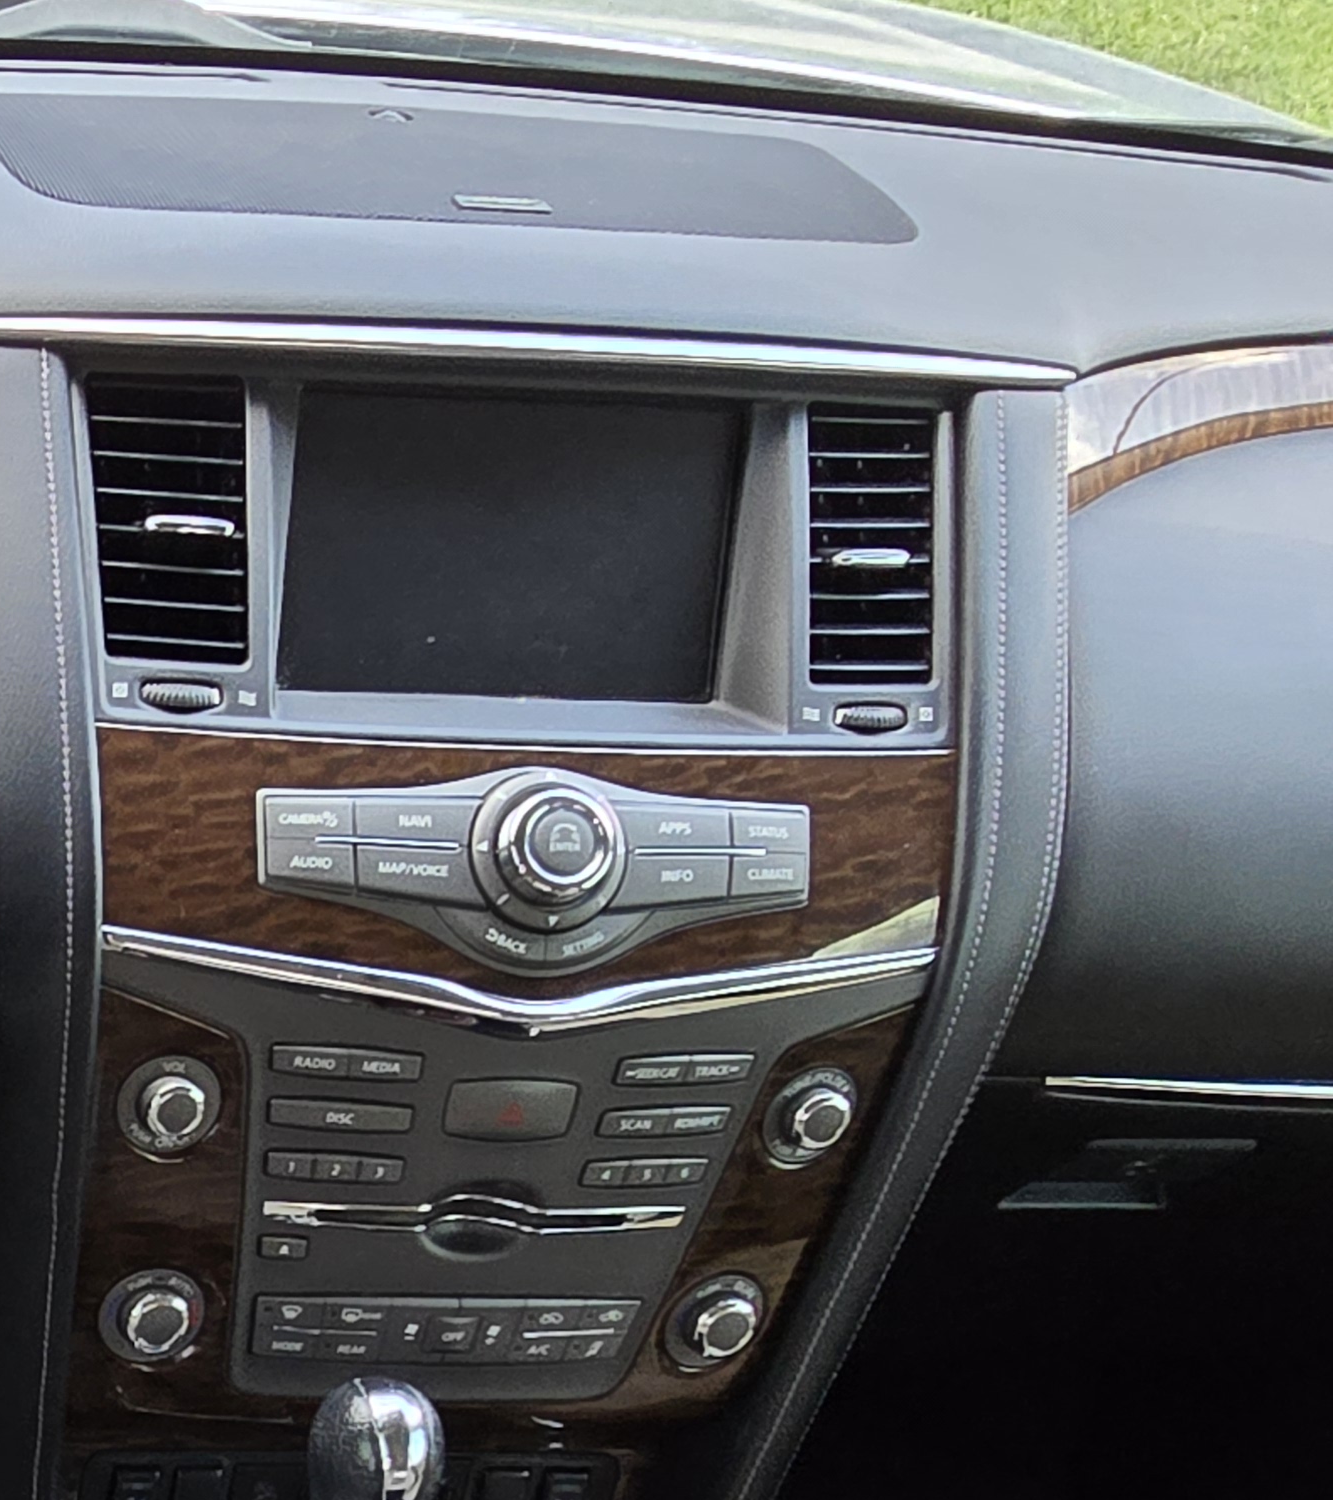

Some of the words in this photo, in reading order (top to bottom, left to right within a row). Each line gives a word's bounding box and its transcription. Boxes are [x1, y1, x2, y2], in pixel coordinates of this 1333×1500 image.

[278, 812, 323, 826] CAMERA
[398, 814, 433, 828] NAVI
[657, 820, 693, 836] APPS
[747, 825, 790, 840] STATUS
[289, 855, 334, 870] AUDIO
[378, 861, 450, 878] MAP/VOICE
[660, 868, 694, 883] INFO
[746, 867, 795, 881] CLIMATE
[497, 932, 528, 955] BACK
[293, 1055, 337, 1071] RADIO
[361, 1061, 402, 1075] MEDIA
[325, 1111, 356, 1126] DISC
[619, 1118, 653, 1132] SCAN
[330, 1163, 342, 1177] 2
[440, 1331, 466, 1343] OFF
